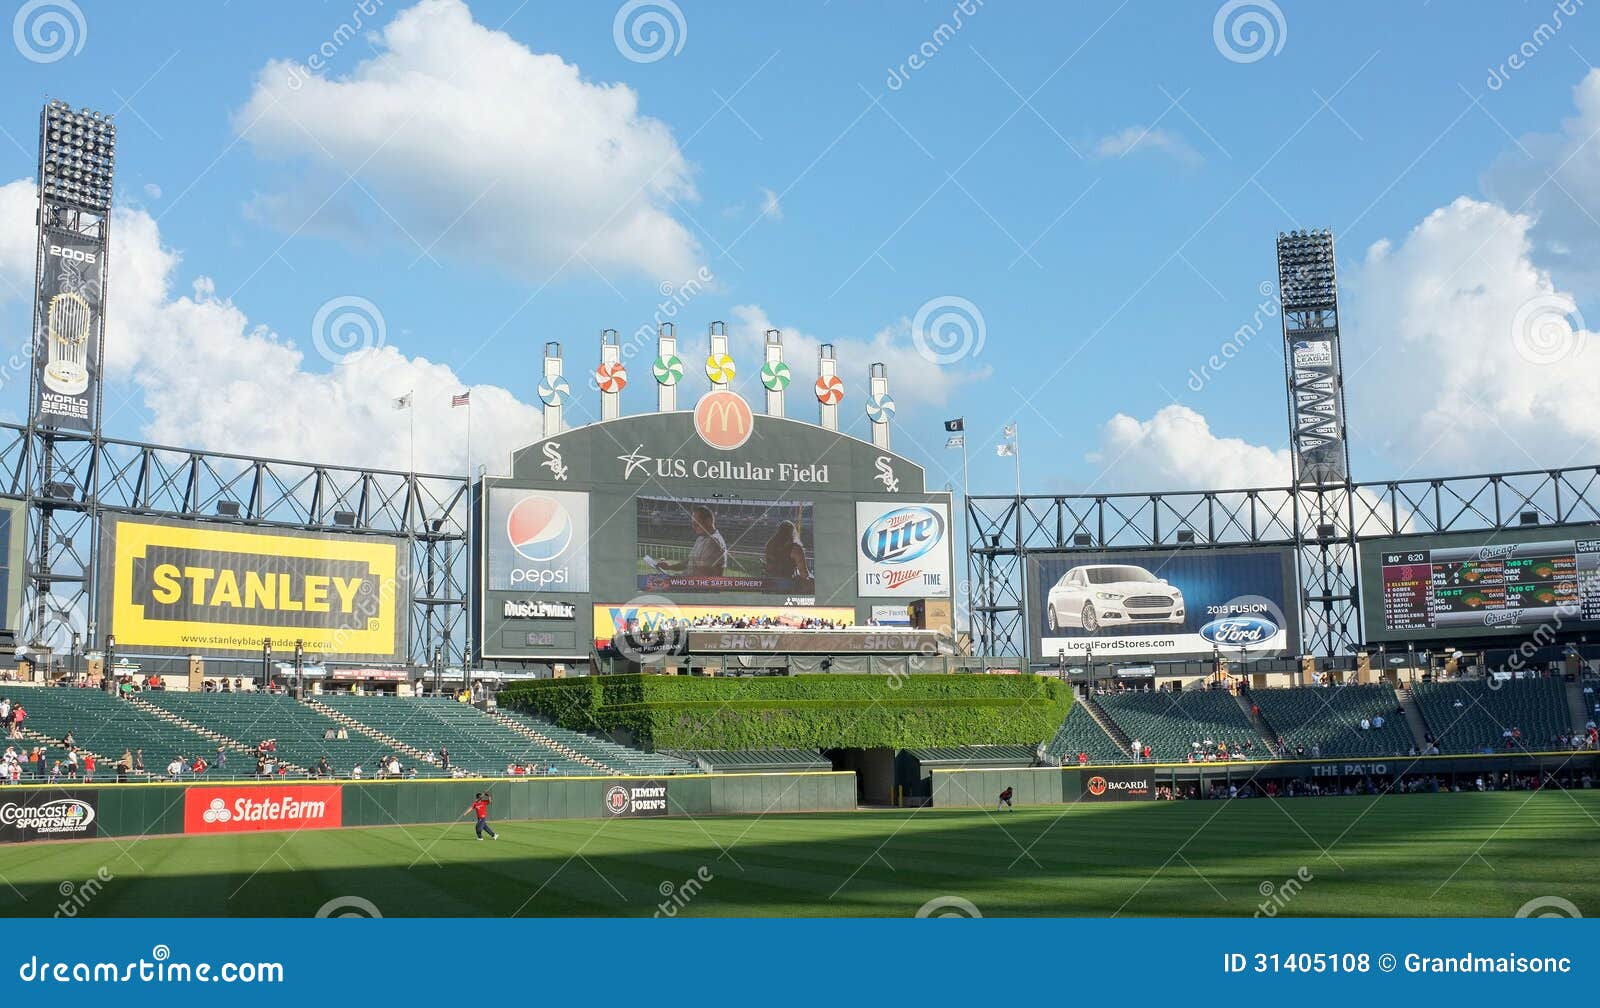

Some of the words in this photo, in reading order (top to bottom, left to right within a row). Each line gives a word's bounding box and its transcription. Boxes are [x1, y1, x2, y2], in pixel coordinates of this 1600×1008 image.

[50, 245, 96, 263] 2005
[42, 392, 88, 406] WORLD
[41, 401, 88, 413] SERIES
[41, 408, 88, 419] CHAMPIONS
[656, 458, 688, 478] U.S.
[693, 460, 775, 481] Cellular
[778, 463, 829, 483] Field
[874, 517, 934, 563] Lite
[1407, 553, 1424, 562] 6:20
[511, 567, 569, 586] pepsi
[866, 573, 881, 585] IT'S
[882, 569, 922, 589] Miller
[923, 574, 941, 585] TIME
[152, 563, 364, 613] STANLEY
[734, 580, 763, 588] DRIVER?
[1207, 606, 1229, 615] 2013
[1230, 604, 1268, 614] FUSION
[1484, 610, 1525, 626] Chicago
[1215, 621, 1262, 641] Ford
[720, 635, 780, 650] SHOW
[863, 636, 921, 650] SHOW
[1067, 640, 1175, 650] LocalFordStores.com
[1312, 765, 1338, 776] THE
[631, 788, 666, 800] JIMMY
[5, 803, 67, 820] Comcast
[631, 800, 666, 812] JOHN'S
[16, 816, 83, 829] SPORTSNET
